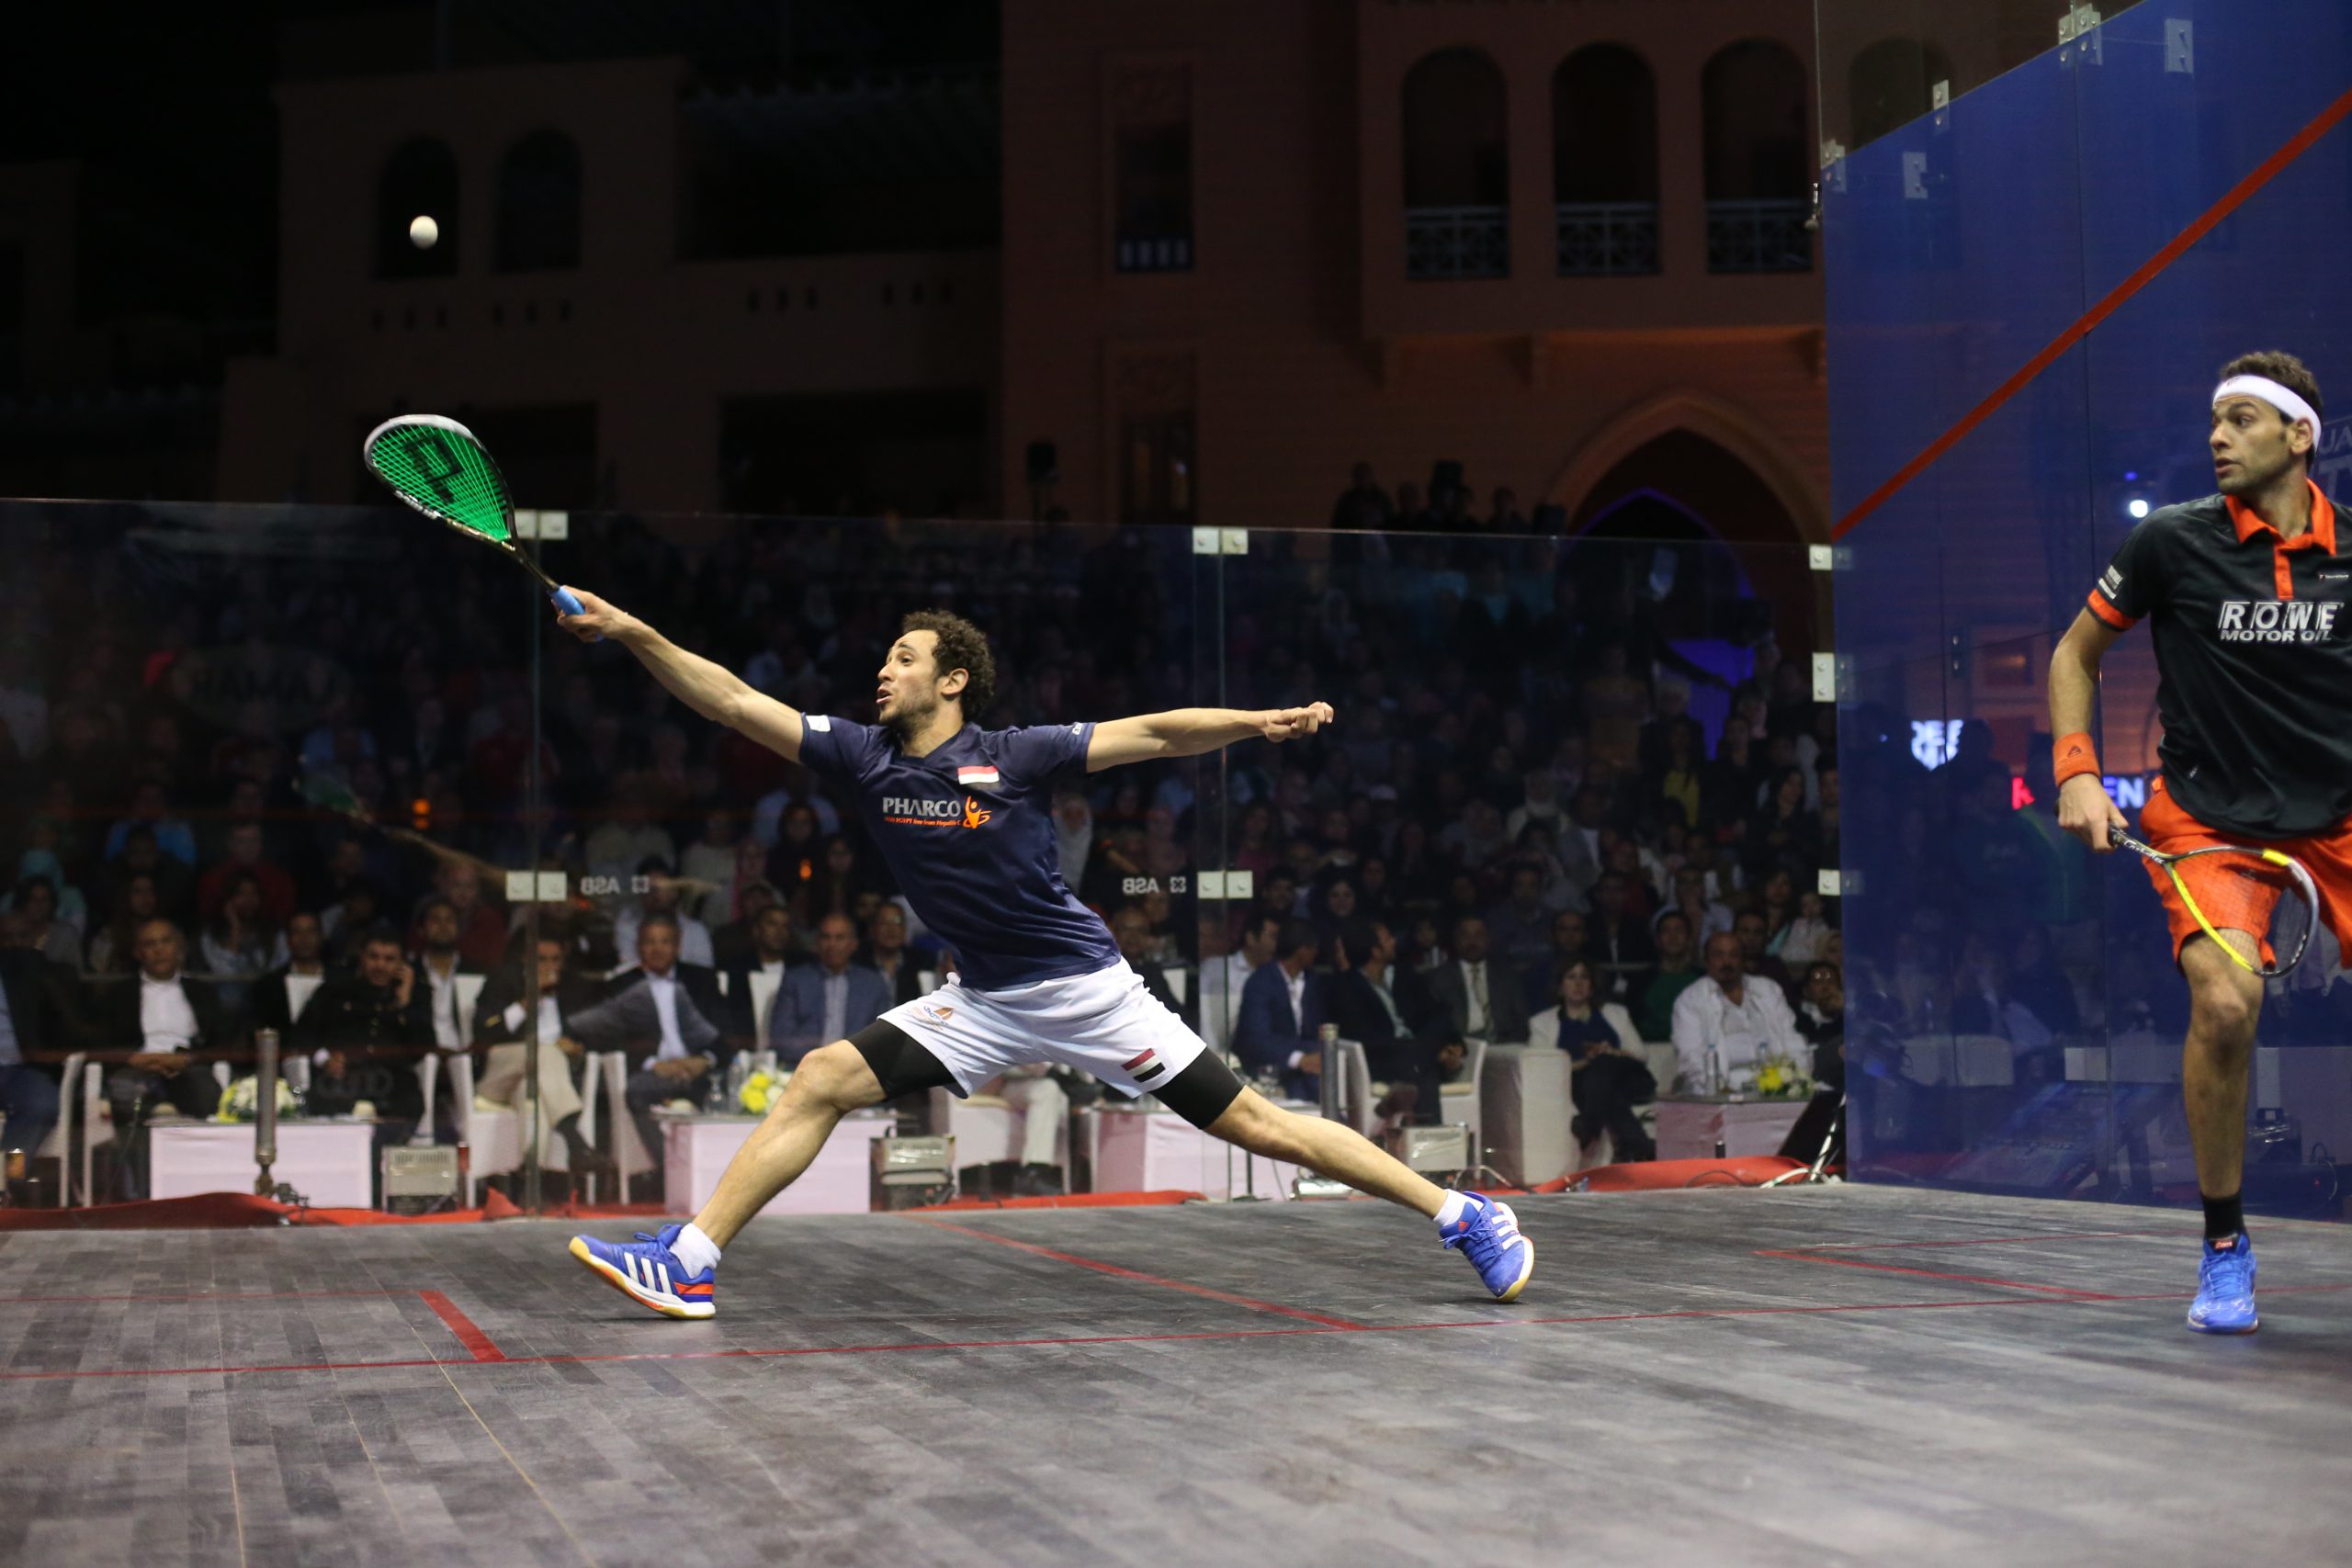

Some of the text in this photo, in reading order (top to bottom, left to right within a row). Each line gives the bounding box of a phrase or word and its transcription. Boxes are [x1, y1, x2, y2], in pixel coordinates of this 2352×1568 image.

[2219, 601, 2339, 630] ROWE
[2220, 630, 2332, 641] MOTOR OIL
[882, 796, 961, 818] PHARCO
